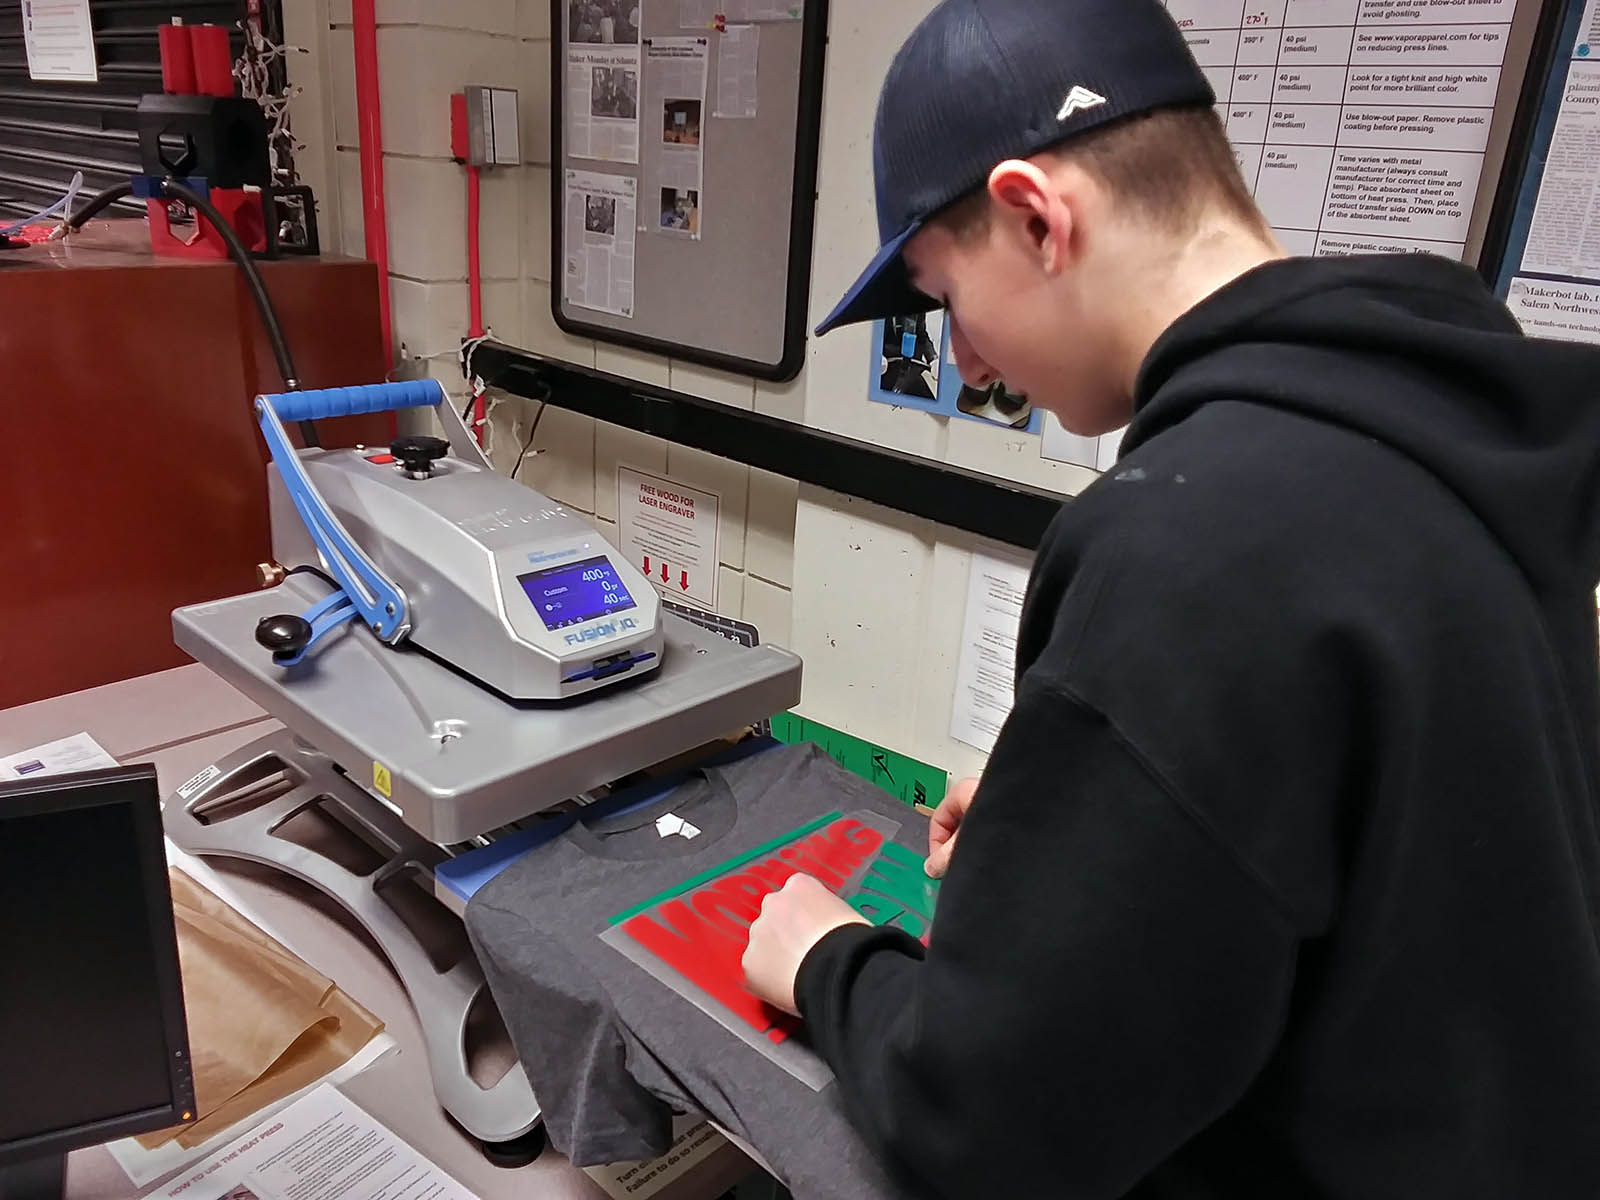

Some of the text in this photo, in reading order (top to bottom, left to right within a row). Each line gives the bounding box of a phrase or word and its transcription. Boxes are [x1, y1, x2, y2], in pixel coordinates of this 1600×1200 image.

[1385, 10, 1422, 18] ghosting.
[1295, 36, 1306, 44] psi
[1374, 34, 1467, 42] www.vaporapparel.com
[1483, 33, 1499, 41] tips
[1284, 45, 1317, 53] (medium)
[1368, 44, 1401, 52] reducing
[1391, 74, 1409, 83] tight
[1445, 75, 1463, 83] high
[1566, 95, 1600, 105] County
[1362, 114, 1395, 122] blow-out
[1423, 115, 1455, 123] Remove
[1344, 124, 1371, 132] coating
[1265, 162, 1297, 170] (medium)
[1336, 165, 1385, 174] manufacturer
[1387, 167, 1416, 175] (always
[1335, 174, 1383, 182] manufacturer
[1398, 177, 1426, 185] correct
[1380, 186, 1418, 194] absorbent
[1420, 188, 1442, 196] sheet
[1414, 198, 1435, 206] Then,
[1329, 202, 1357, 210] product
[1359, 204, 1388, 212] transfer
[1390, 205, 1406, 213] side
[1408, 206, 1434, 214] DOWN
[1448, 210, 1461, 218] top
[1350, 213, 1387, 221] absorbent
[1389, 215, 1412, 223] sheet.
[1321, 240, 1351, 248] Remove
[1352, 242, 1377, 250] plastic
[1526, 287, 1571, 300] Makerbot
[1521, 299, 1600, 315] Salem Northwes
[1534, 320, 1567, 328] hands-on
[640, 483, 695, 508] FREE WOOD FOR
[639, 495, 695, 520] LASER ENGRAVER
[582, 568, 604, 582] 400
[601, 581, 611, 591] 0
[604, 593, 618, 604] 40
[564, 618, 637, 646] FUSION IQ
[168, 1122, 284, 1197] HOW TO USE THE HEAT PRESS
[616, 1168, 639, 1183] Turn
[626, 1170, 657, 1193] Failure
[656, 1164, 668, 1172] to
[668, 1156, 680, 1165] do
[680, 1148, 690, 1157] so
